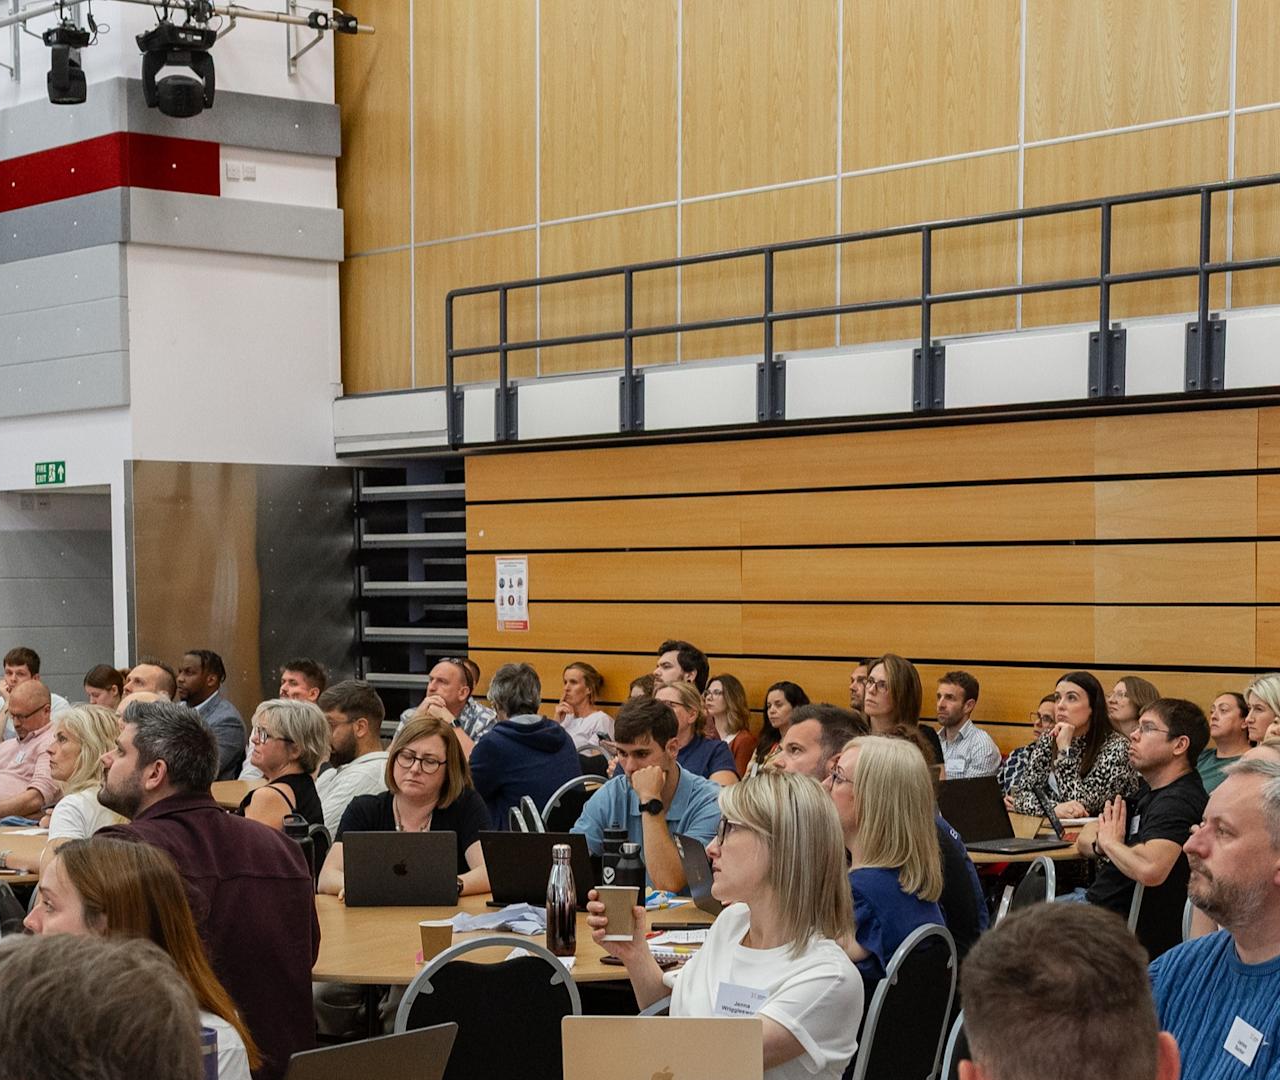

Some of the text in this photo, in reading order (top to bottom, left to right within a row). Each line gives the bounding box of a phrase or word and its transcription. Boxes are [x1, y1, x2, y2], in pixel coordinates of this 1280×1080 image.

[36, 464, 47, 473] FIRE
[36, 474, 47, 483] EXIT
[734, 1001, 751, 1009] Jenna
